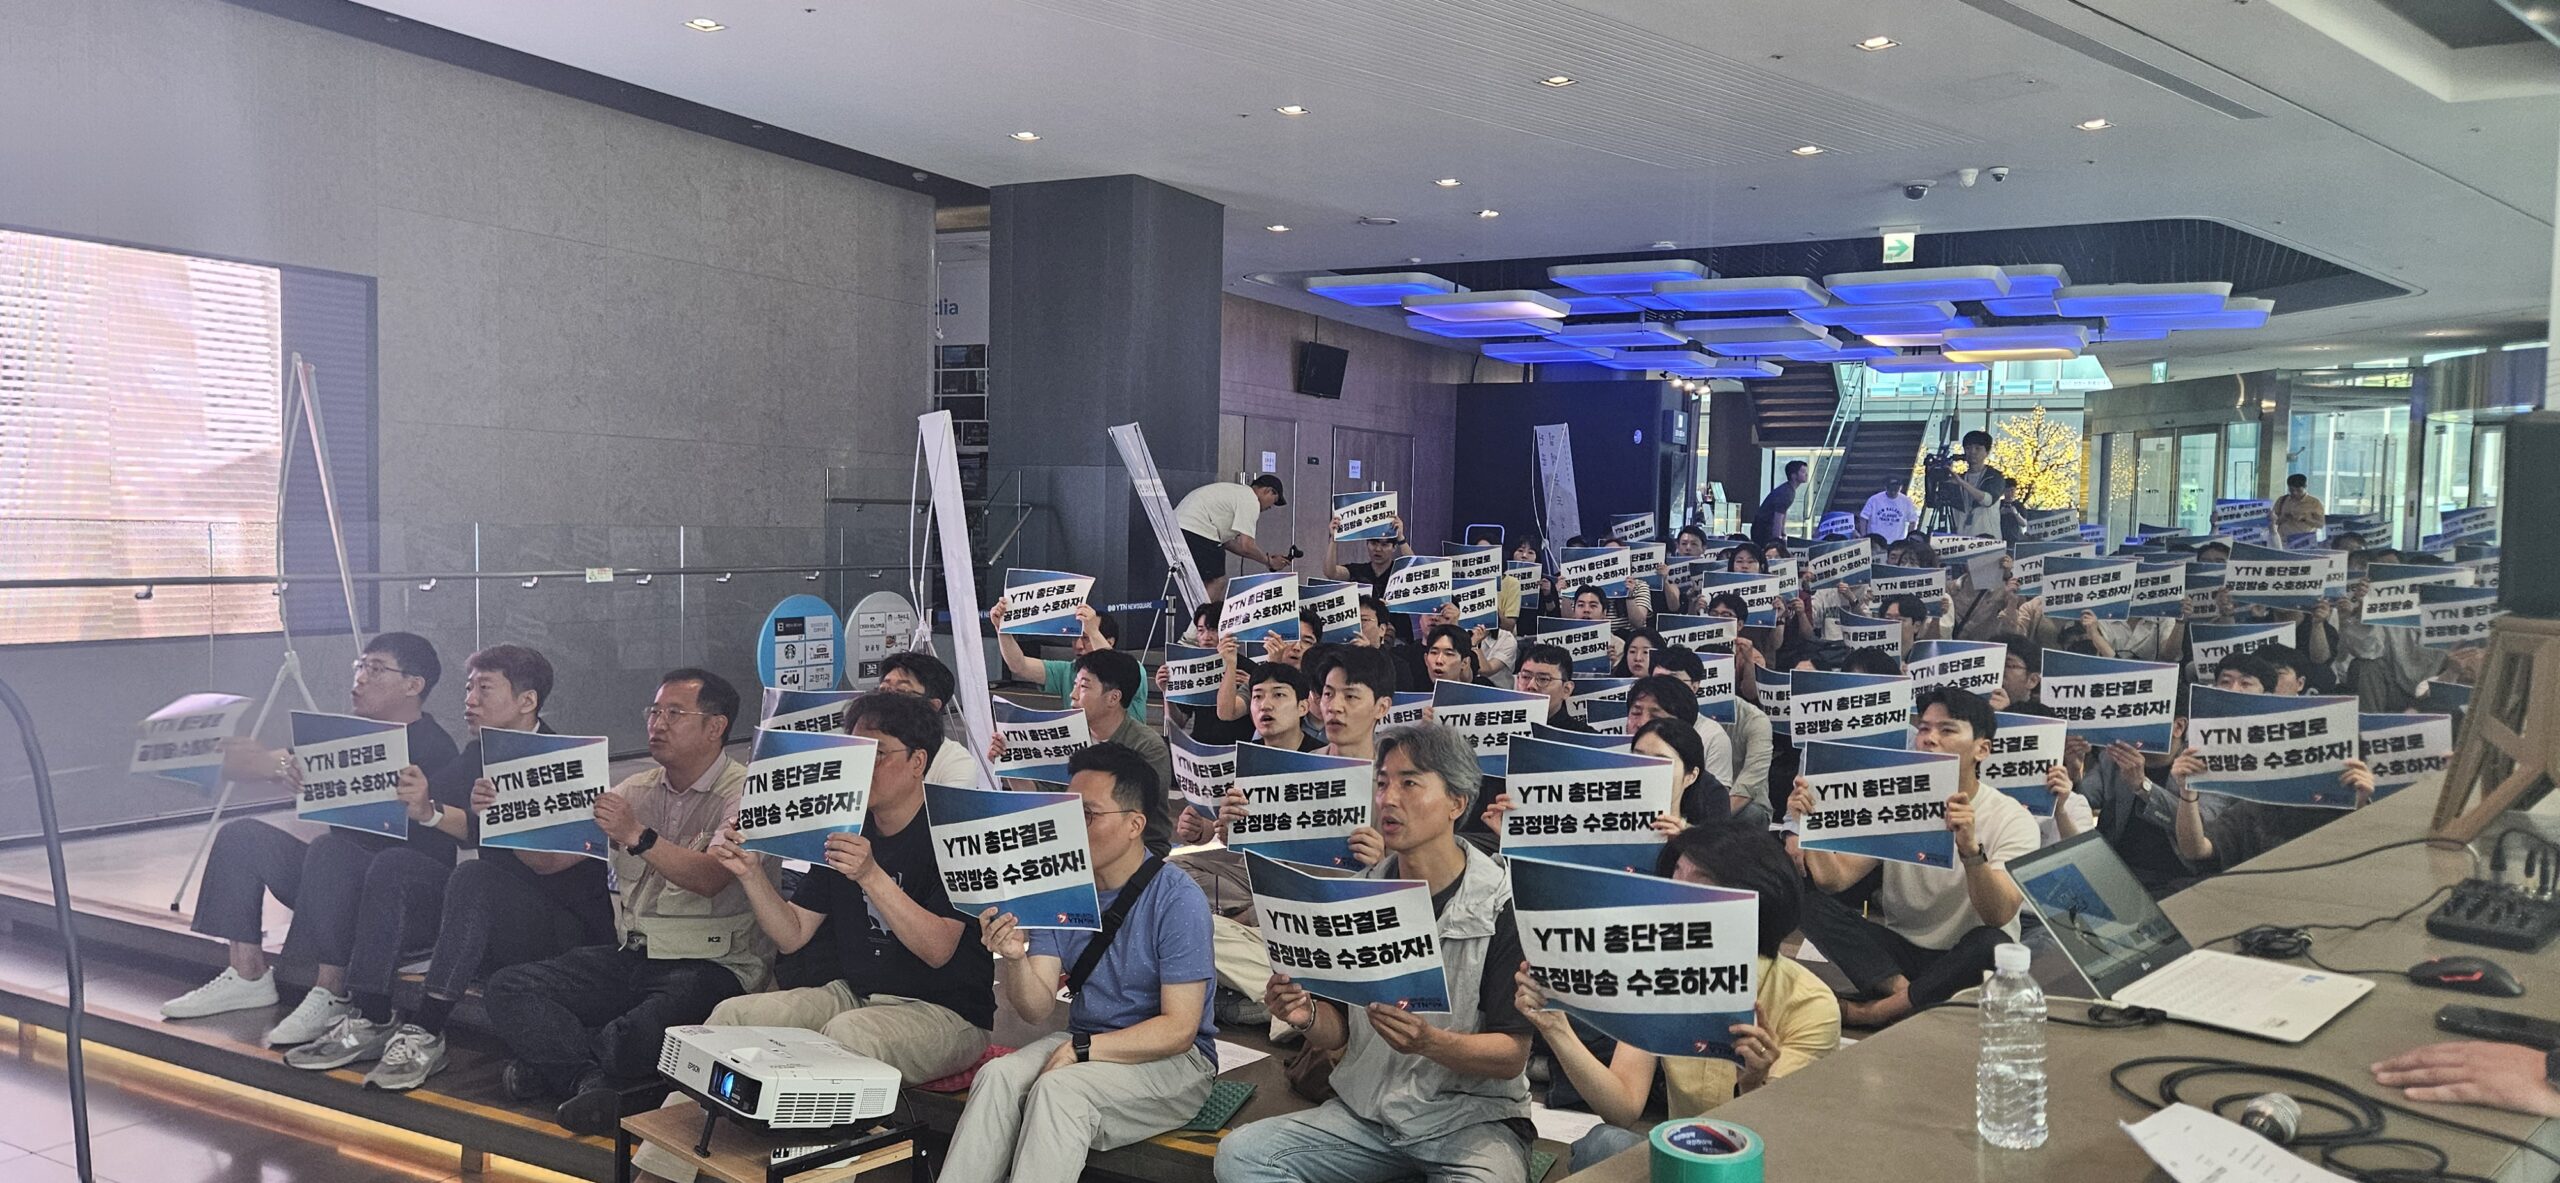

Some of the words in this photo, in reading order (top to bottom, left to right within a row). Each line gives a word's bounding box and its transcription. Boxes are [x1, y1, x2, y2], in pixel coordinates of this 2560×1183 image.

[1340, 508, 1356, 520] YTN
[1358, 500, 1387, 515] 총단결로
[1337, 519, 1362, 533] 공정방송
[1364, 510, 1395, 524] 수호하자!
[1462, 555, 1491, 567] 총단결로
[1631, 552, 1654, 562] 단결로
[1812, 558, 1831, 570] YTN
[1832, 548, 1861, 563] 총단결로
[1840, 557, 1870, 572] 수호하자!
[1467, 564, 1500, 578] 수호하자!
[1567, 564, 1587, 575] YTN
[1588, 557, 1619, 570] 총단결로
[1595, 568, 1629, 581] 수호하자!
[1669, 566, 1688, 576] 총단결
[2020, 560, 2042, 572] YTN
[2234, 566, 2262, 576] YTN
[2265, 565, 2311, 577] 총단결로
[1406, 568, 1440, 582] 총단결로
[2018, 573, 2042, 585] 공정방
[2050, 578, 2076, 590] YTN
[2078, 571, 2121, 587] 총단결로
[1010, 589, 1034, 603] YTN
[1036, 583, 1076, 599] 총단결로
[1412, 581, 1450, 595] 수호하자!
[1520, 581, 1539, 591] 호하자!
[1733, 584, 1766, 597] 총단결로
[1877, 582, 1898, 591] YTN
[1900, 578, 1933, 589] 총단결로
[2225, 580, 2269, 591] 공정방송
[2272, 579, 2323, 591] 수호하자!
[2375, 585, 2405, 597] YTN
[1228, 598, 1246, 613] YTN
[1248, 586, 1283, 606] 총단결로
[1457, 588, 1486, 602] 총단결로
[1746, 595, 1776, 608] 호하자!
[1916, 588, 1943, 599] 호하자!
[2045, 593, 2083, 607] 공정방송
[2087, 584, 2131, 600] 수호하자!
[2137, 586, 2182, 601] 수호하자!
[2188, 592, 2209, 601] YTN
[1003, 604, 1039, 621] 공정방송
[1042, 596, 1084, 614] 수호하자!
[1115, 601, 1127, 610] YTN
[1128, 601, 1153, 610] NEWSQUARE
[1461, 598, 1496, 613] 수호하자!
[2193, 604, 2217, 613] 정방송
[2366, 600, 2413, 614] 공정방송
[2429, 608, 2460, 620] YTN
[1220, 613, 1250, 631] 공정방송
[1253, 600, 1296, 620] 수호하자!
[1321, 607, 1357, 627] 수호하자!
[1543, 636, 1563, 646] YTN
[1565, 630, 1599, 644] 총단결로
[1664, 634, 1686, 645] YTN
[1688, 628, 1724, 643] 총단결로
[1852, 630, 1887, 641] 총단결로
[2425, 624, 2470, 637] 공정방송
[1572, 641, 1609, 656] 수호하자!
[2201, 646, 2230, 658] YTN
[1171, 664, 1188, 675] YTN
[1189, 658, 1224, 674] 총단결로
[1910, 665, 1936, 681] YTN
[1938, 656, 1985, 675] 총단결로
[1167, 678, 1195, 691] 공정방송
[1196, 672, 1224, 687] 수호하
[1697, 682, 1732, 698] 호하자!
[1947, 673, 1999, 690] 수호하자!
[2052, 683, 2085, 699] YTN
[2090, 679, 2153, 697] 총단결로
[1573, 701, 1586, 711] YT
[1801, 699, 1832, 714] YTN
[1836, 691, 1891, 711] 총단결로
[2101, 700, 2170, 719] 수호하자!
[1393, 708, 1423, 724] 총단결
[1439, 713, 1471, 727] YTN
[1474, 709, 1527, 726] 총단결로
[1794, 718, 1843, 735] 공정방송
[1847, 709, 1906, 730] 수호하자!
[1003, 729, 1028, 742] YTN
[1029, 725, 1071, 742] 총단결로
[2200, 727, 2242, 746] YTN
[2247, 718, 2328, 744] 총단결로
[1991, 735, 2039, 753] 단결로
[304, 751, 335, 773] YTN
[338, 743, 387, 769] 총단결로
[1000, 747, 1042, 762] 공정방송
[2264, 740, 2353, 769] 수호하자!
[771, 759, 842, 791] 총단결로
[1177, 755, 1193, 772] YTN
[1192, 760, 1235, 778] 총단결로
[490, 771, 524, 794] YTN
[526, 760, 585, 788] 총단결로
[302, 780, 348, 802] 공정방송
[350, 770, 399, 795] 수호하자
[1201, 782, 1235, 798] 수호하
[1243, 786, 1279, 803] YTN
[1284, 779, 1346, 802] 총단결로
[1518, 784, 1563, 804] YTN
[1568, 779, 1642, 802] 총단결로
[1816, 781, 1857, 800] YTN
[1862, 774, 1930, 798] 총단결로
[486, 801, 541, 826] 공정방송
[785, 790, 864, 822] 수호하자!
[1232, 811, 1292, 834] 공정방송
[1296, 805, 1366, 829] 수호하자!
[1806, 807, 1873, 830] 공정방송
[1877, 800, 1948, 825] 수호하자
[1508, 814, 1578, 836] 공정방송
[943, 833, 982, 858] YTN
[984, 819, 1058, 855] 총단결로
[944, 865, 999, 893] 공정방송
[1002, 849, 1087, 885] 수호하자!
[1266, 908, 1309, 935] YTN
[1312, 906, 1401, 938] 총단결로
[1533, 927, 1596, 952] YTN
[1604, 921, 1714, 954] 총단결로
[1266, 938, 1332, 969] 공정방송
[1336, 934, 1435, 970] 수호하자!
[1530, 965, 1619, 997] 공정방송
[1627, 964, 1748, 997] 수호하자!
[687, 1061, 701, 1074] EPSON
